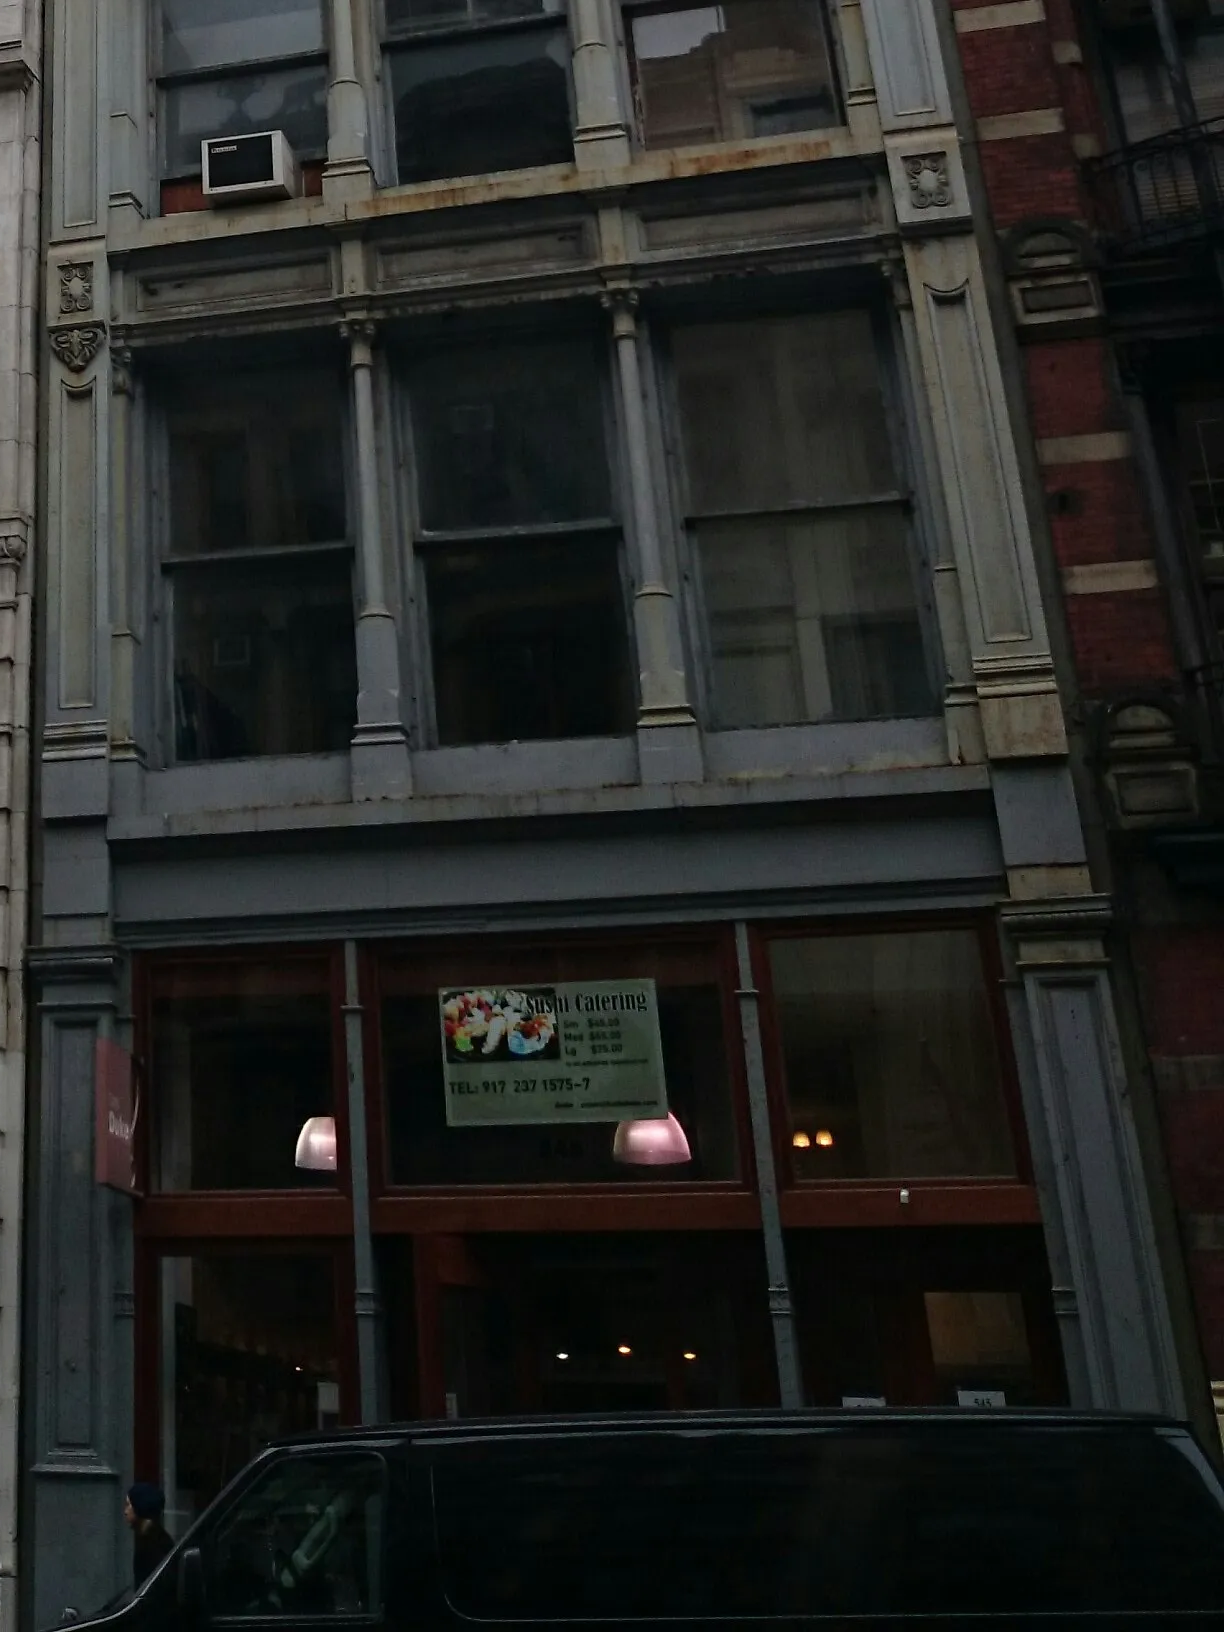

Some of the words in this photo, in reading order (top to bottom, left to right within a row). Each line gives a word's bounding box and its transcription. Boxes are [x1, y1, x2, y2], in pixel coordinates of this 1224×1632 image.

[526, 994, 570, 1014] Sushi
[575, 991, 647, 1013] Catering
[449, 1081, 479, 1095] TEL:
[482, 1081, 506, 1094] 917
[513, 1079, 537, 1093] 237
[542, 1077, 591, 1092] 1575-7
